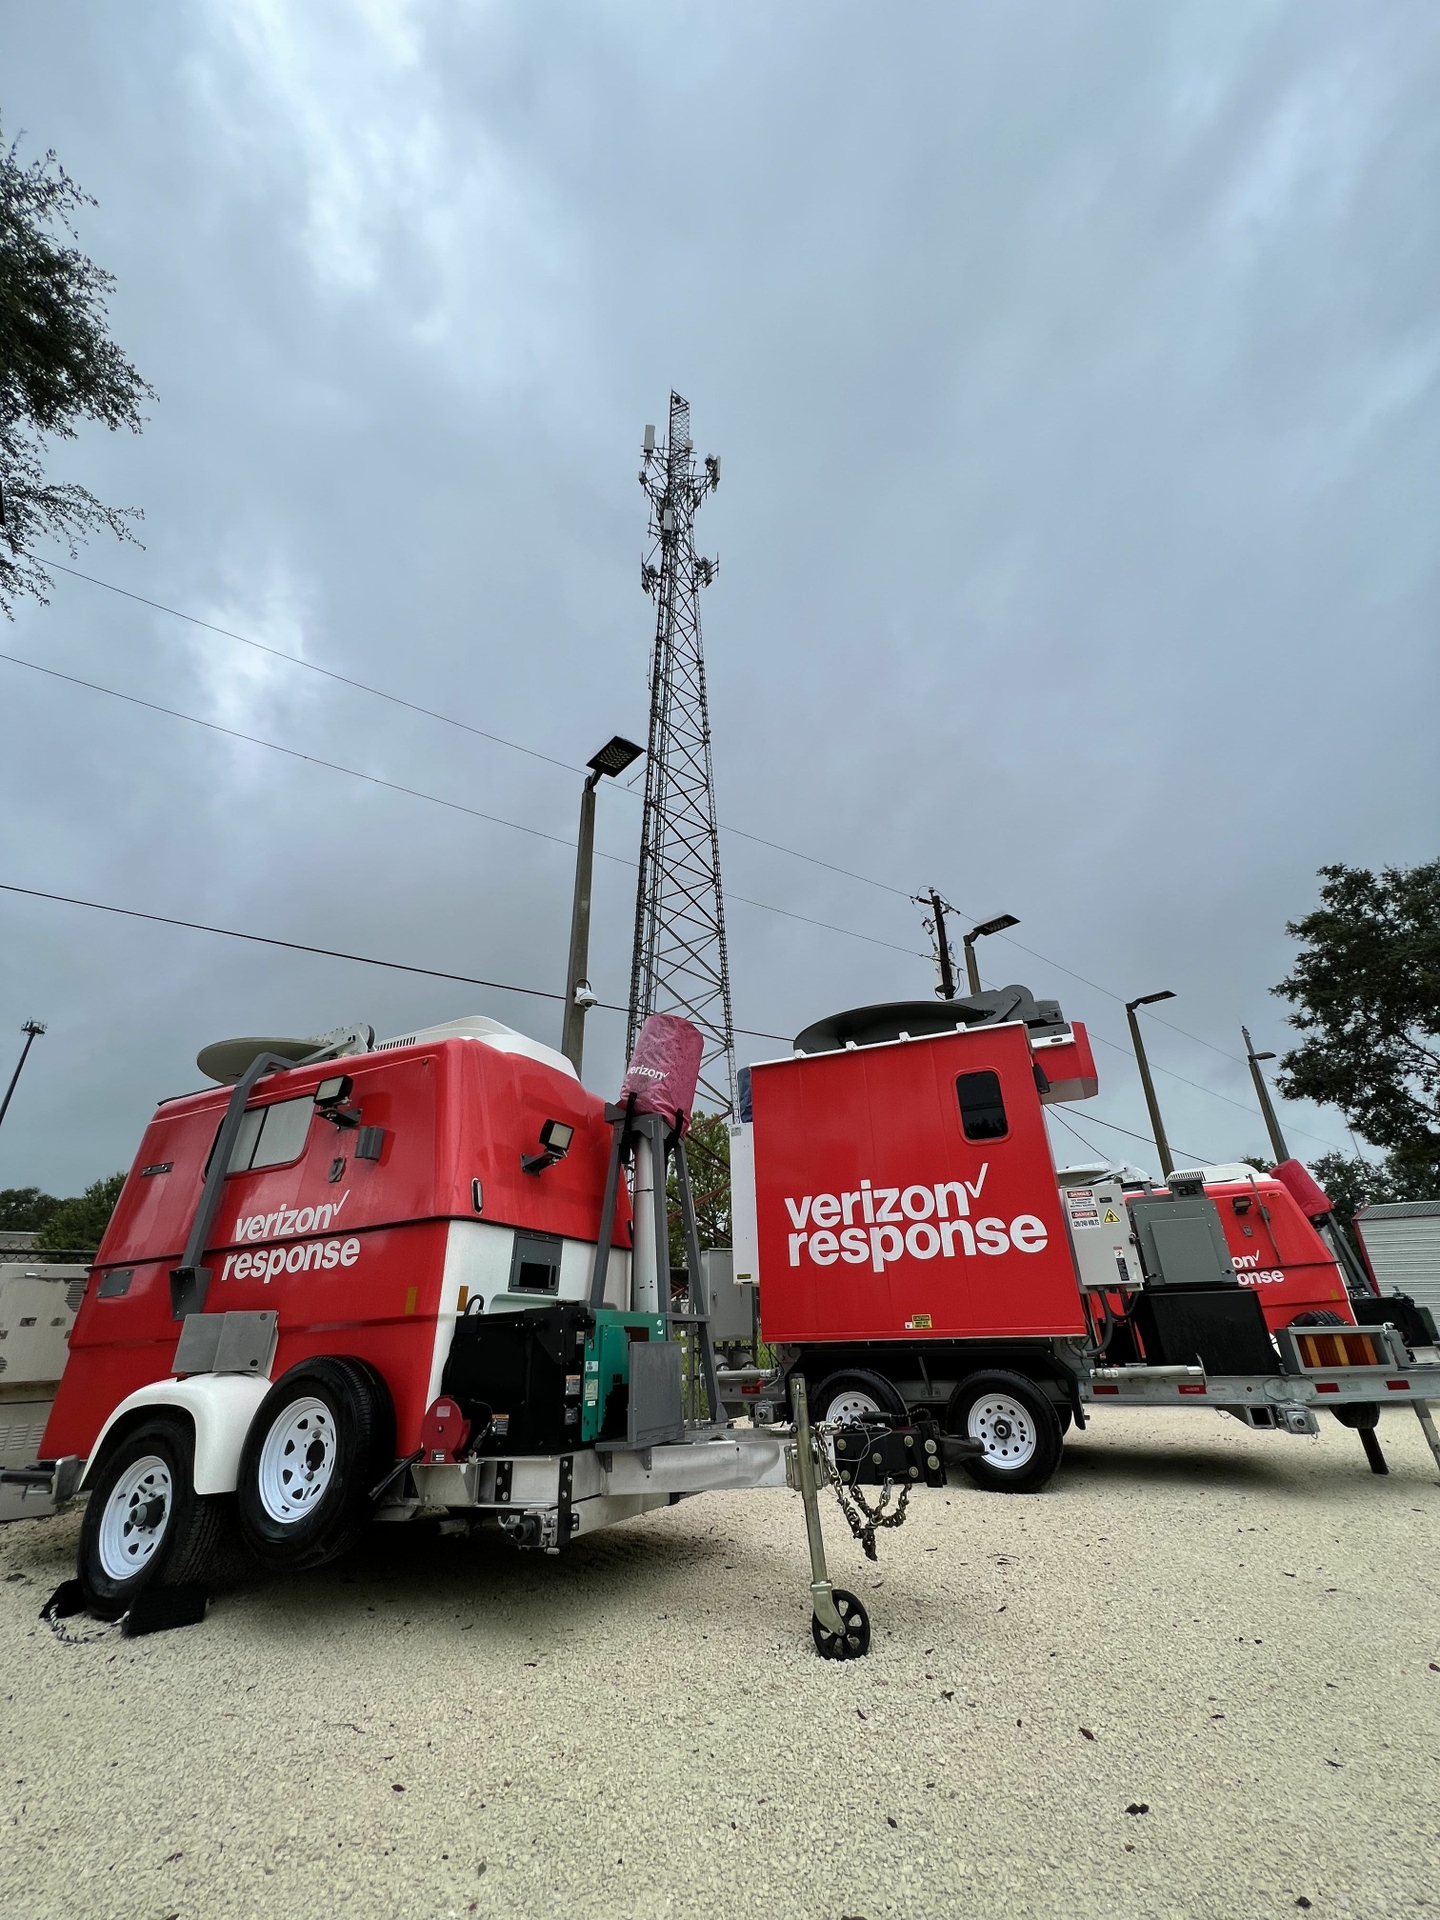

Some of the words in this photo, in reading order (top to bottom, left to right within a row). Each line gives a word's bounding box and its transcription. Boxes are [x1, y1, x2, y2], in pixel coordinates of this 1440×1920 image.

[235, 1203, 333, 1242] verizon
[784, 1179, 970, 1229] verizon
[221, 1237, 361, 1284] response
[788, 1214, 1048, 1273] response
